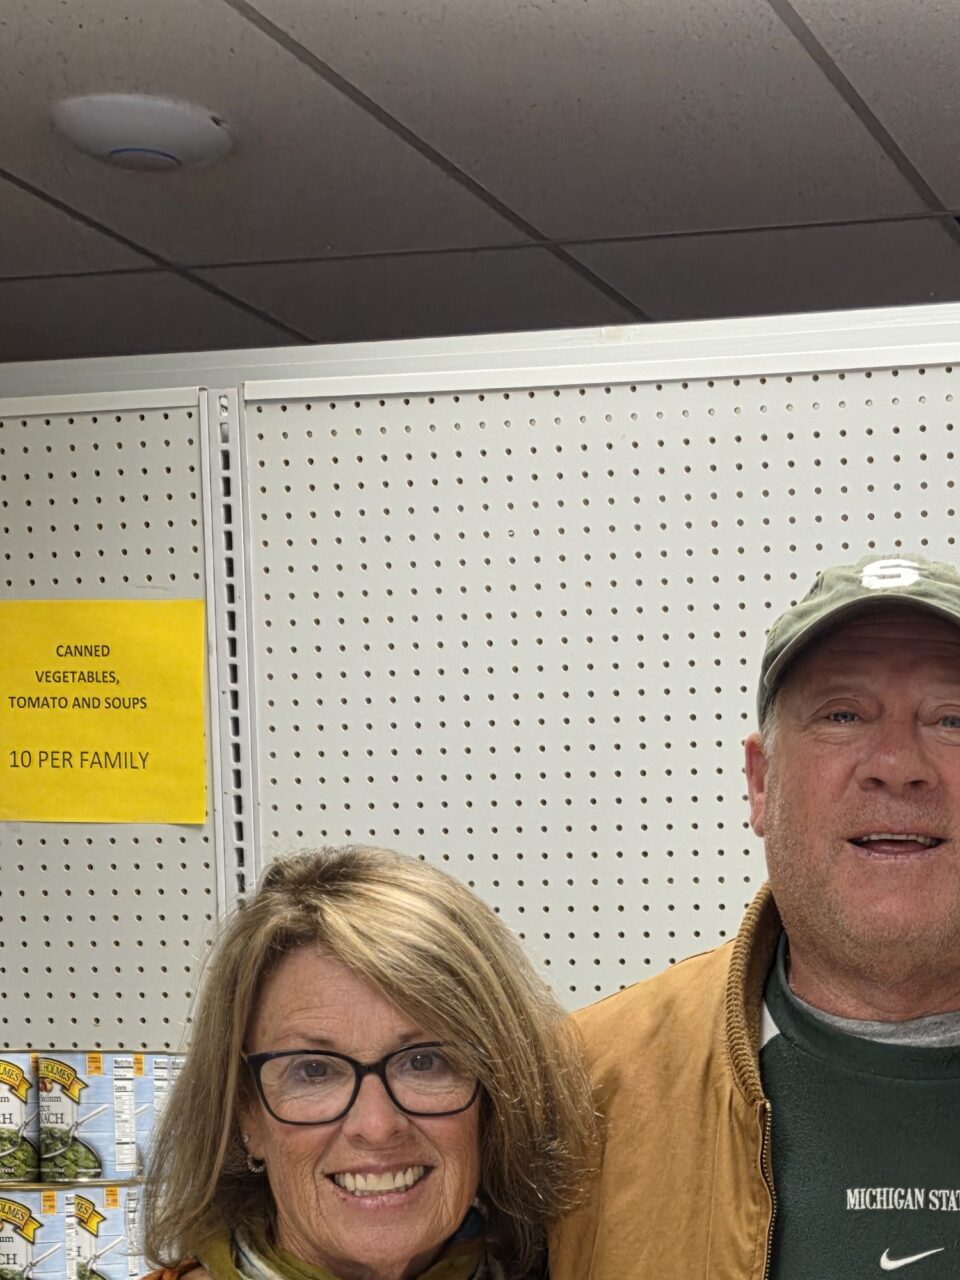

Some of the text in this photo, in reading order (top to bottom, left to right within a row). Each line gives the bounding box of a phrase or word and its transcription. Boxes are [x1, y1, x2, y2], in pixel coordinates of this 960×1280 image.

[56, 645, 110, 657] CANNED
[35, 671, 120, 685] VEGETABLES,
[8, 696, 147, 709] TOMATO AND SOUPS
[9, 750, 149, 769] 10 PER FAMILY
[847, 1187, 925, 1210] MICHIGAN
